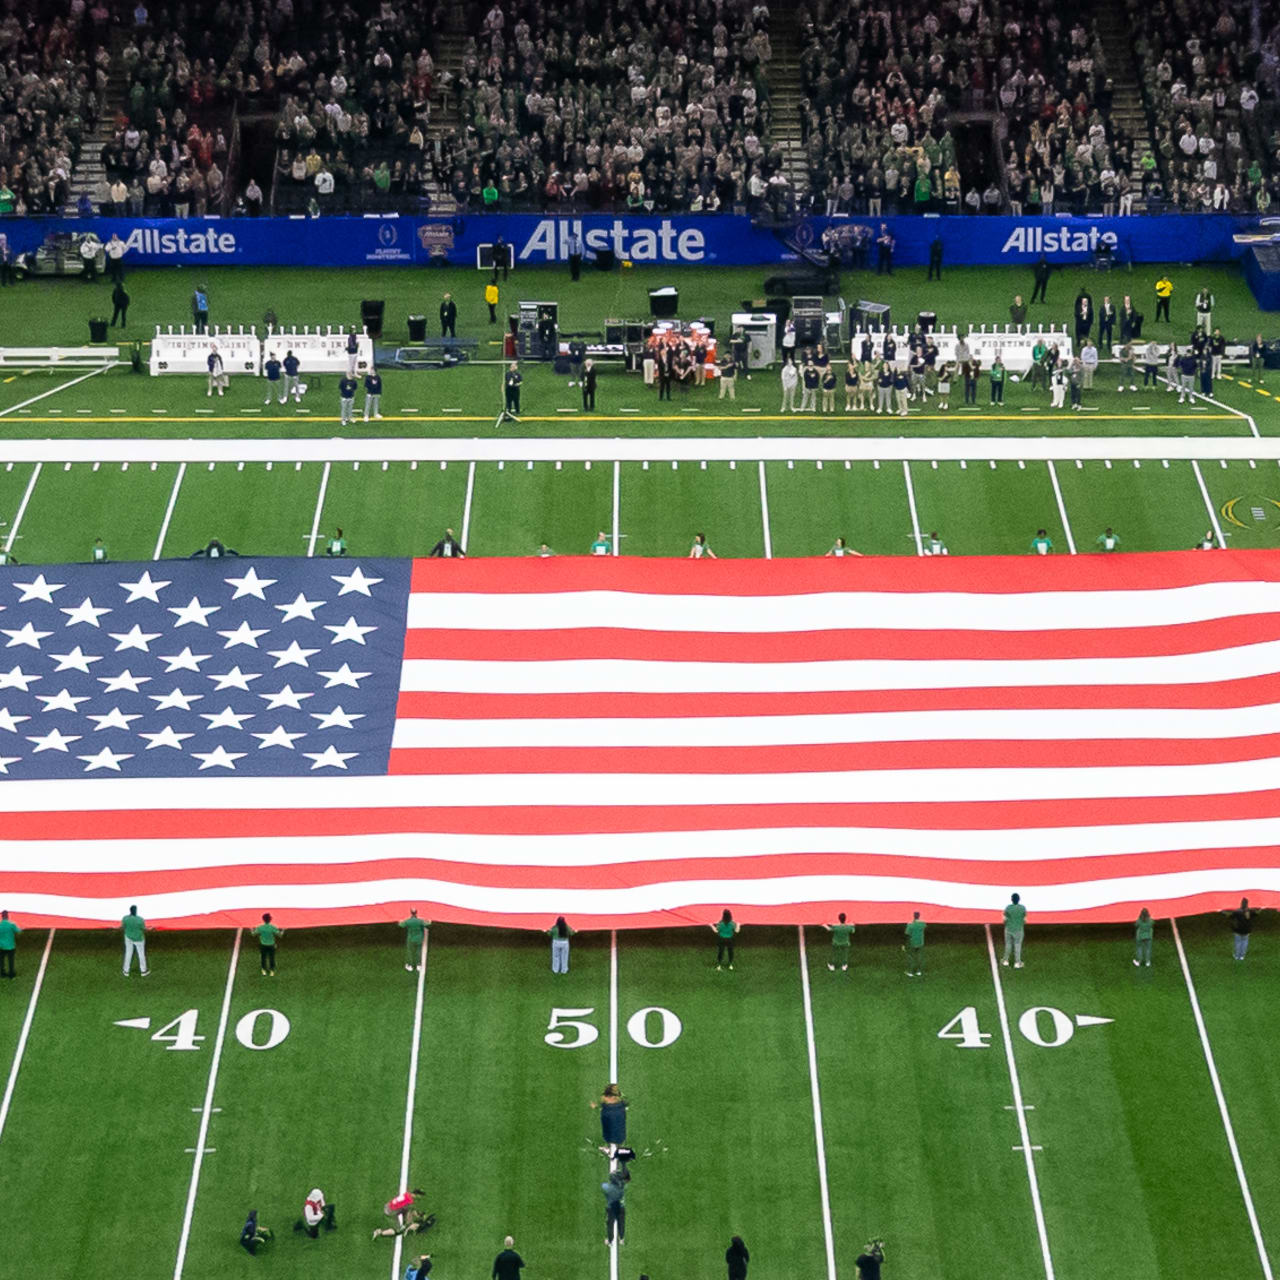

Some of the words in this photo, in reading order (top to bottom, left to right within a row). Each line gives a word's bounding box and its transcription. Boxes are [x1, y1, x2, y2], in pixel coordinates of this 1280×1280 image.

[125, 228, 237, 254] Allstate
[520, 220, 705, 261] Allstate
[1001, 226, 1119, 253] Allstate
